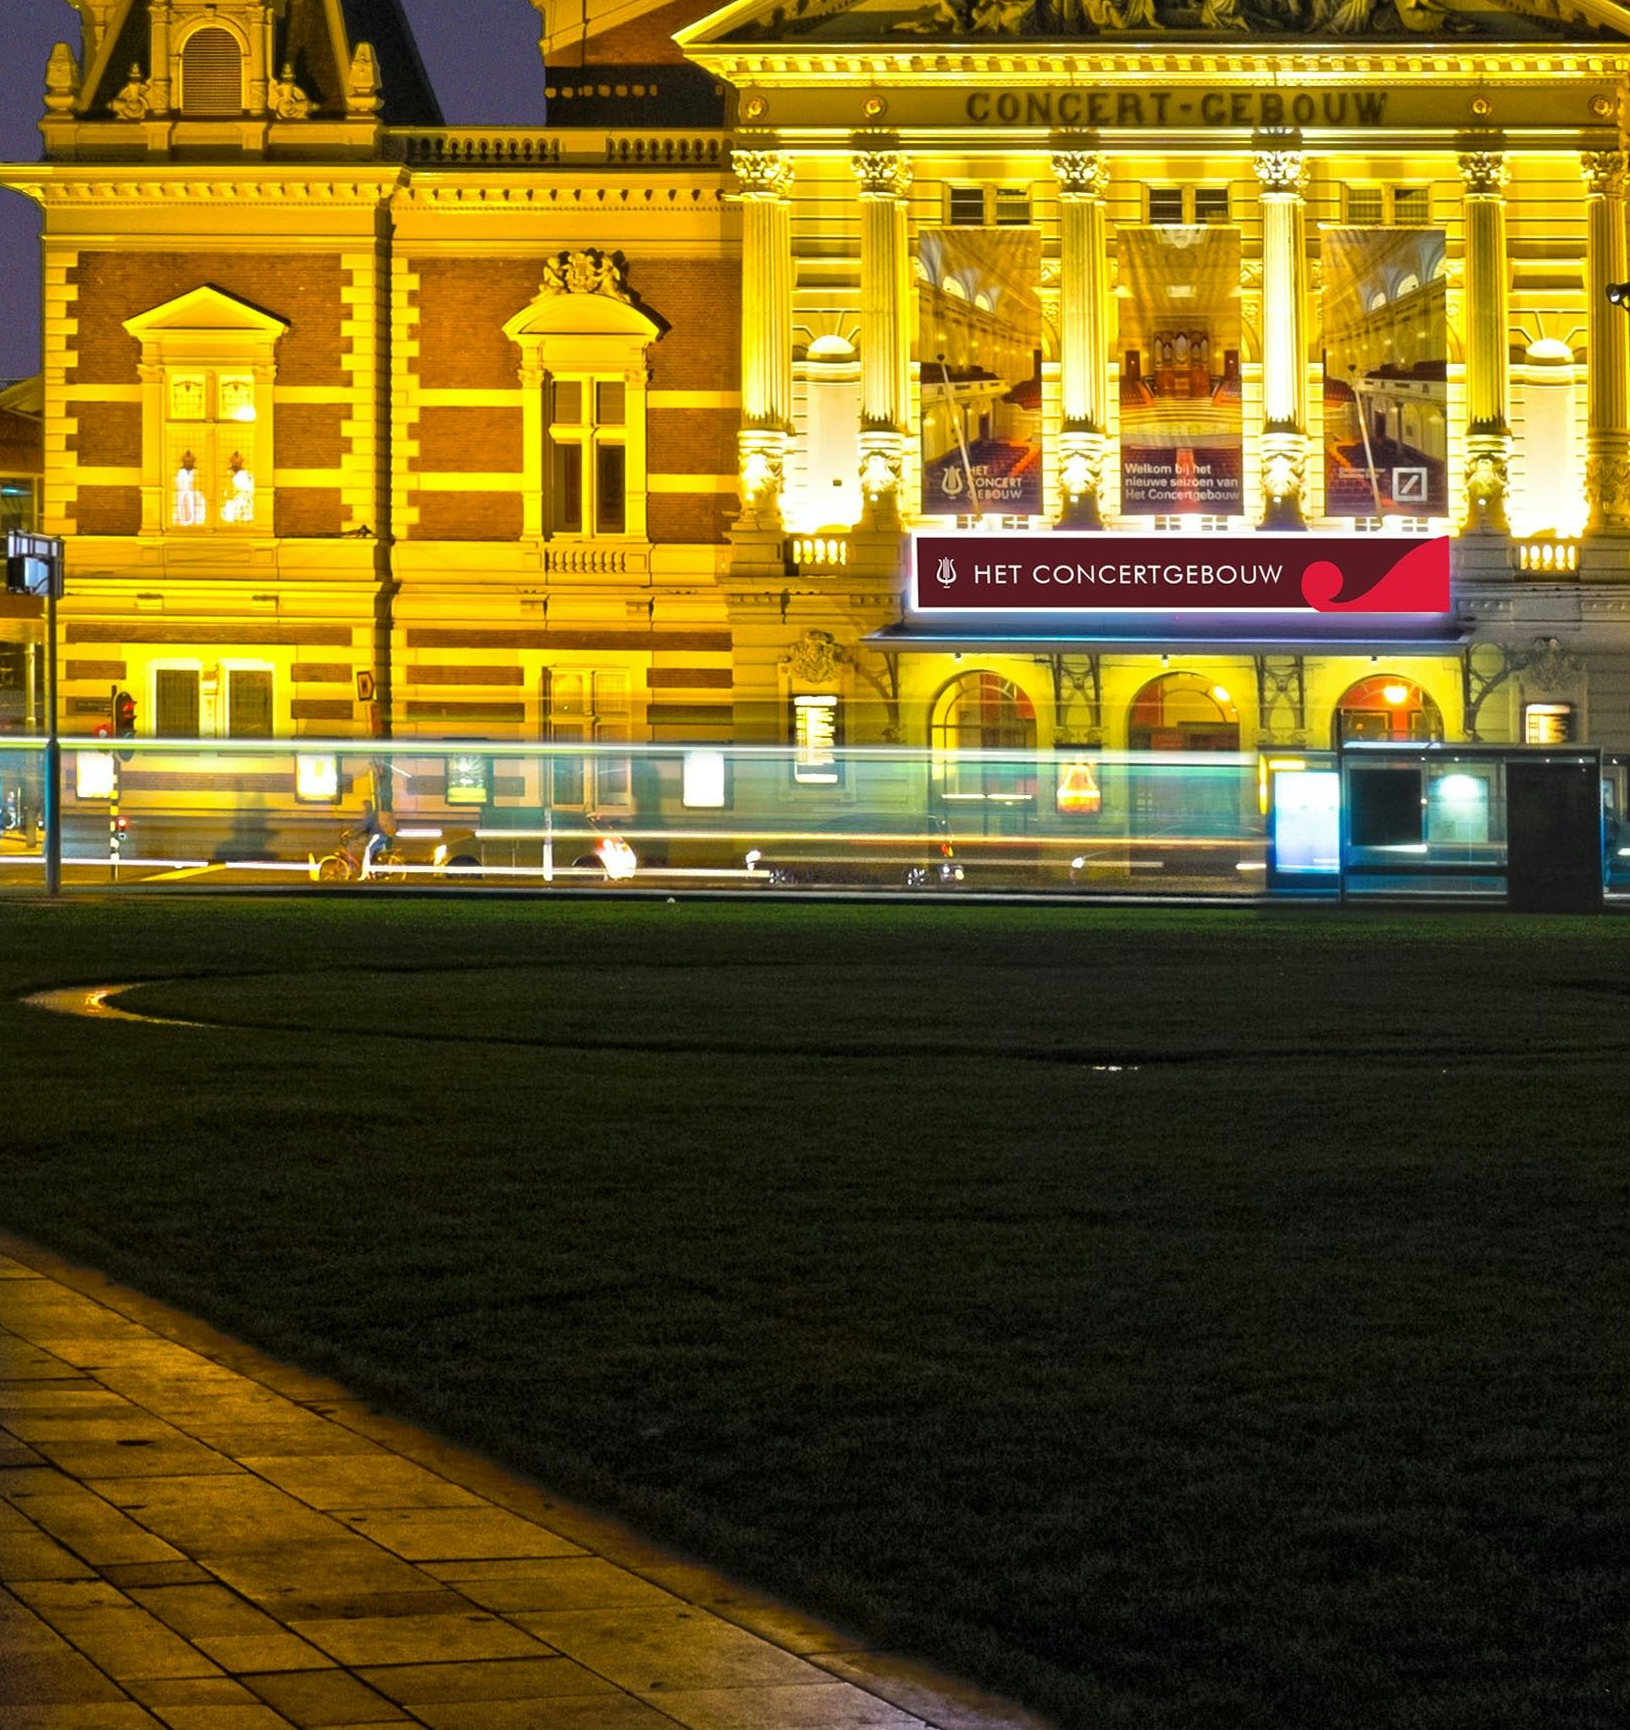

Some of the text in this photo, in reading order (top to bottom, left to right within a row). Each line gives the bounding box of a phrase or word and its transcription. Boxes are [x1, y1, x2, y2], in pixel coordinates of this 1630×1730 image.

[1125, 463, 1211, 476] Welkom bij het
[967, 477, 1022, 488] ONCERT
[1125, 476, 1239, 487] nieuwe seizoen van
[1126, 489, 1240, 502] Het Concertgebouw
[974, 564, 1283, 585] HET CONCERTGEBOUW
